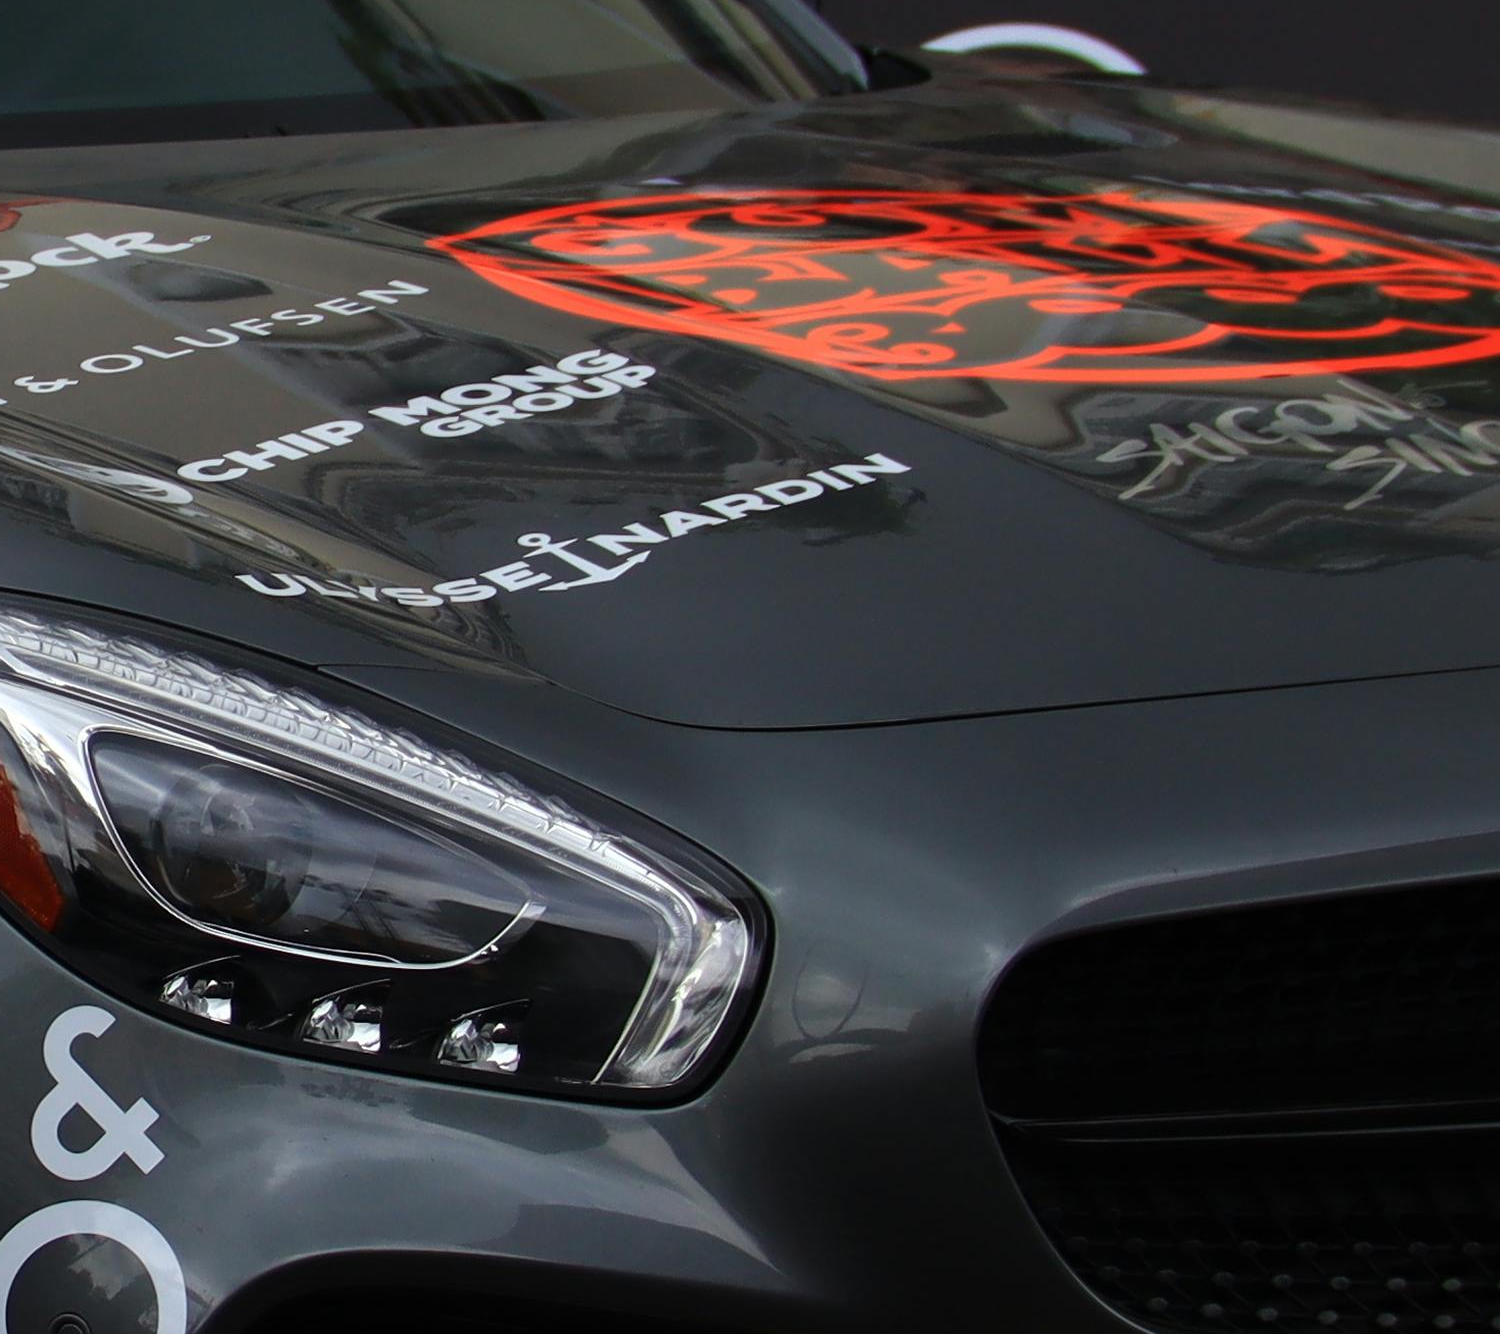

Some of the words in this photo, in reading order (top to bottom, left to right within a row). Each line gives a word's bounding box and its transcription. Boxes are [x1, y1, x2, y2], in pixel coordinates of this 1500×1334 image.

[14, 374, 78, 394] &
[80, 280, 429, 374] OLUFSEN
[176, 419, 366, 483] CHIP
[369, 350, 629, 426] MONG
[420, 362, 656, 438] GROUP
[1095, 378, 1416, 501] SAIGON
[235, 559, 553, 607] ULYSSE
[588, 451, 911, 556] NARDIN
